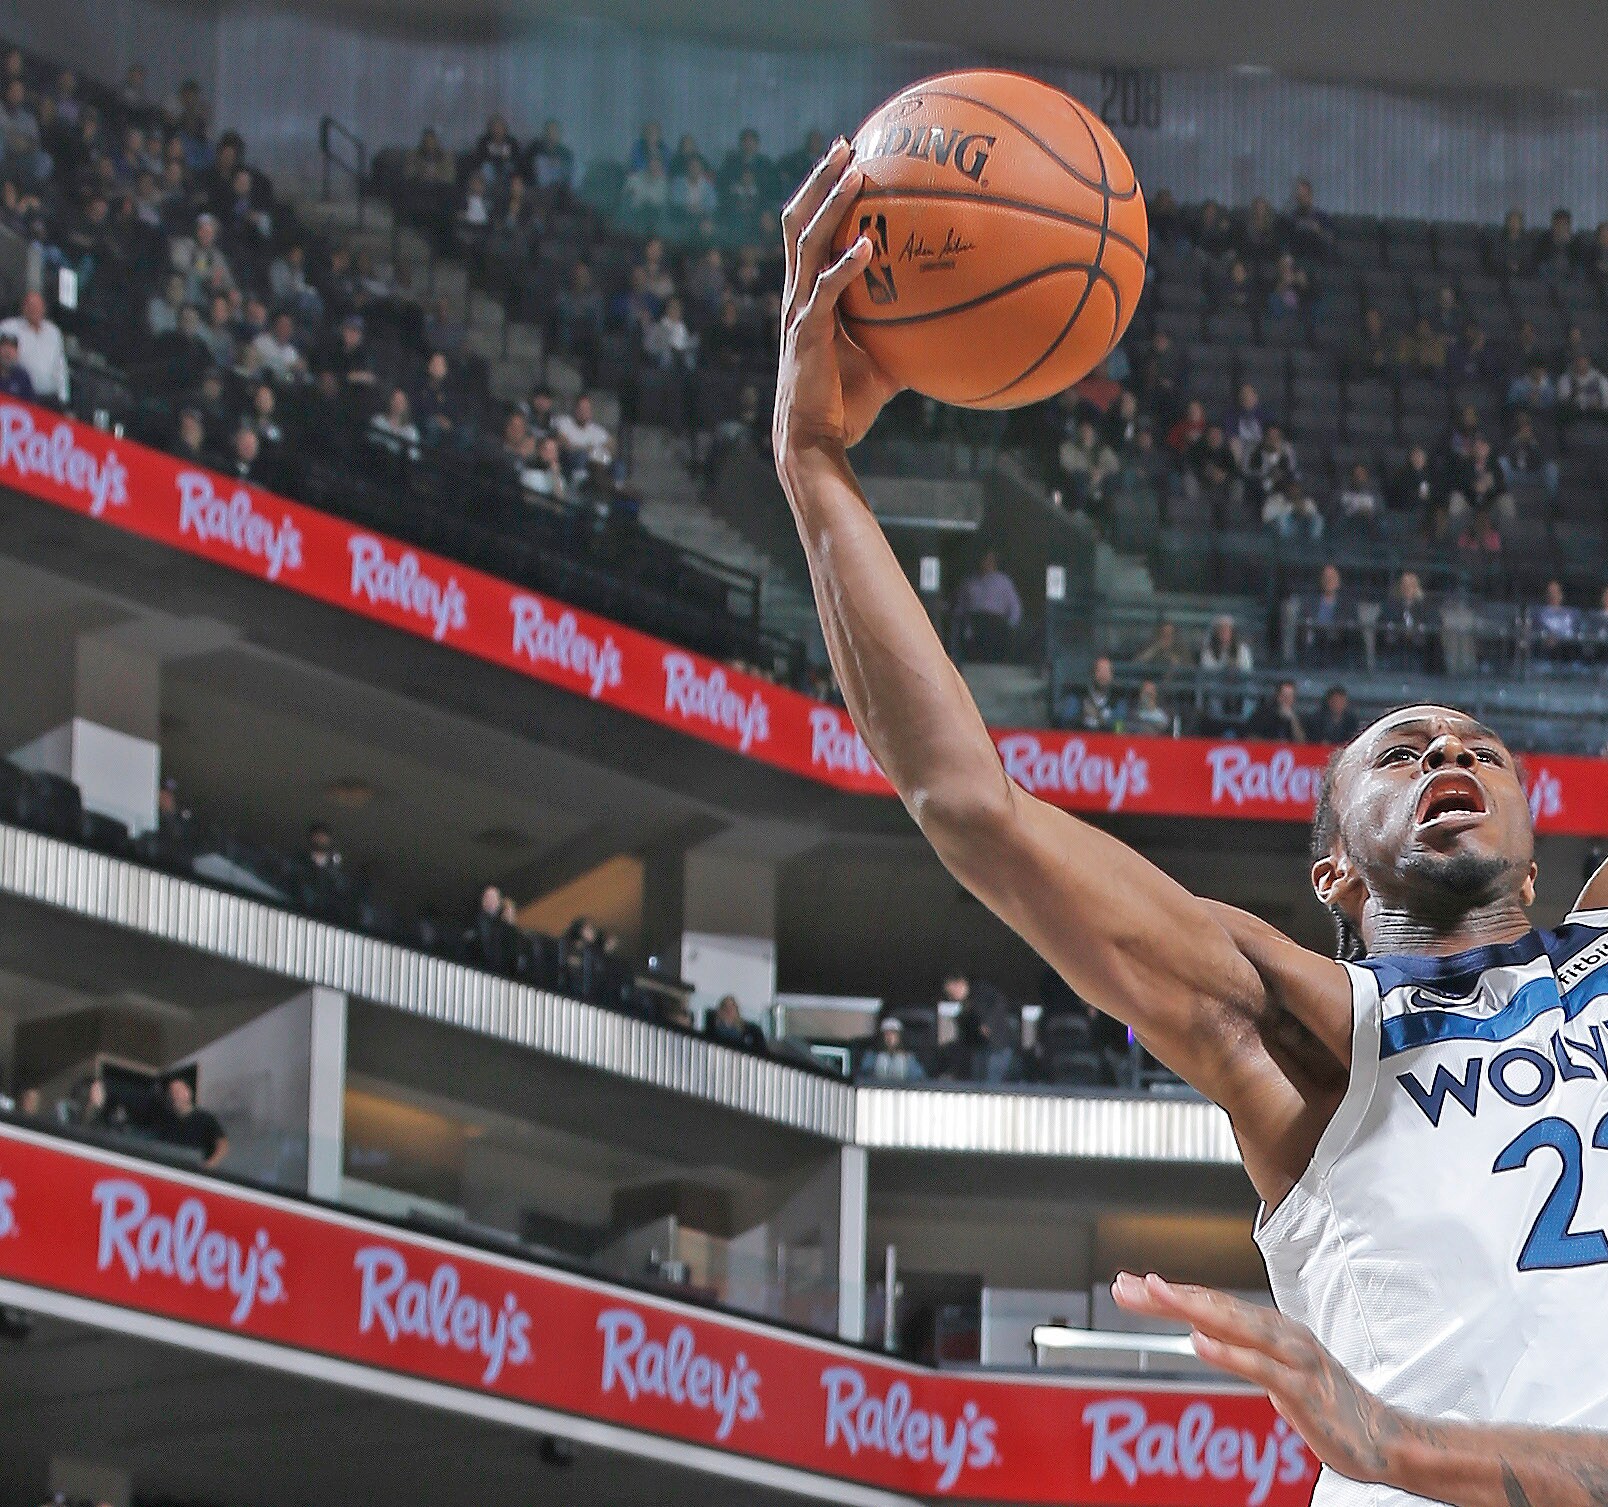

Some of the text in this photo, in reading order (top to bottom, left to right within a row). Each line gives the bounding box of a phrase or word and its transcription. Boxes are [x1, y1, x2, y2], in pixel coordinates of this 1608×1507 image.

[0, 405, 128, 517] Raley's
[176, 471, 302, 580] Raley's
[348, 534, 467, 641] Raley's
[509, 594, 622, 698] Raley's
[662, 652, 769, 753] Raley's
[999, 734, 1149, 811] Raley's
[93, 1179, 286, 1325] Raley's
[354, 1246, 532, 1385] Raley's
[597, 1310, 762, 1440] Raley's
[819, 1366, 999, 1492] Raley's
[1082, 1398, 1308, 1506] Raley's
